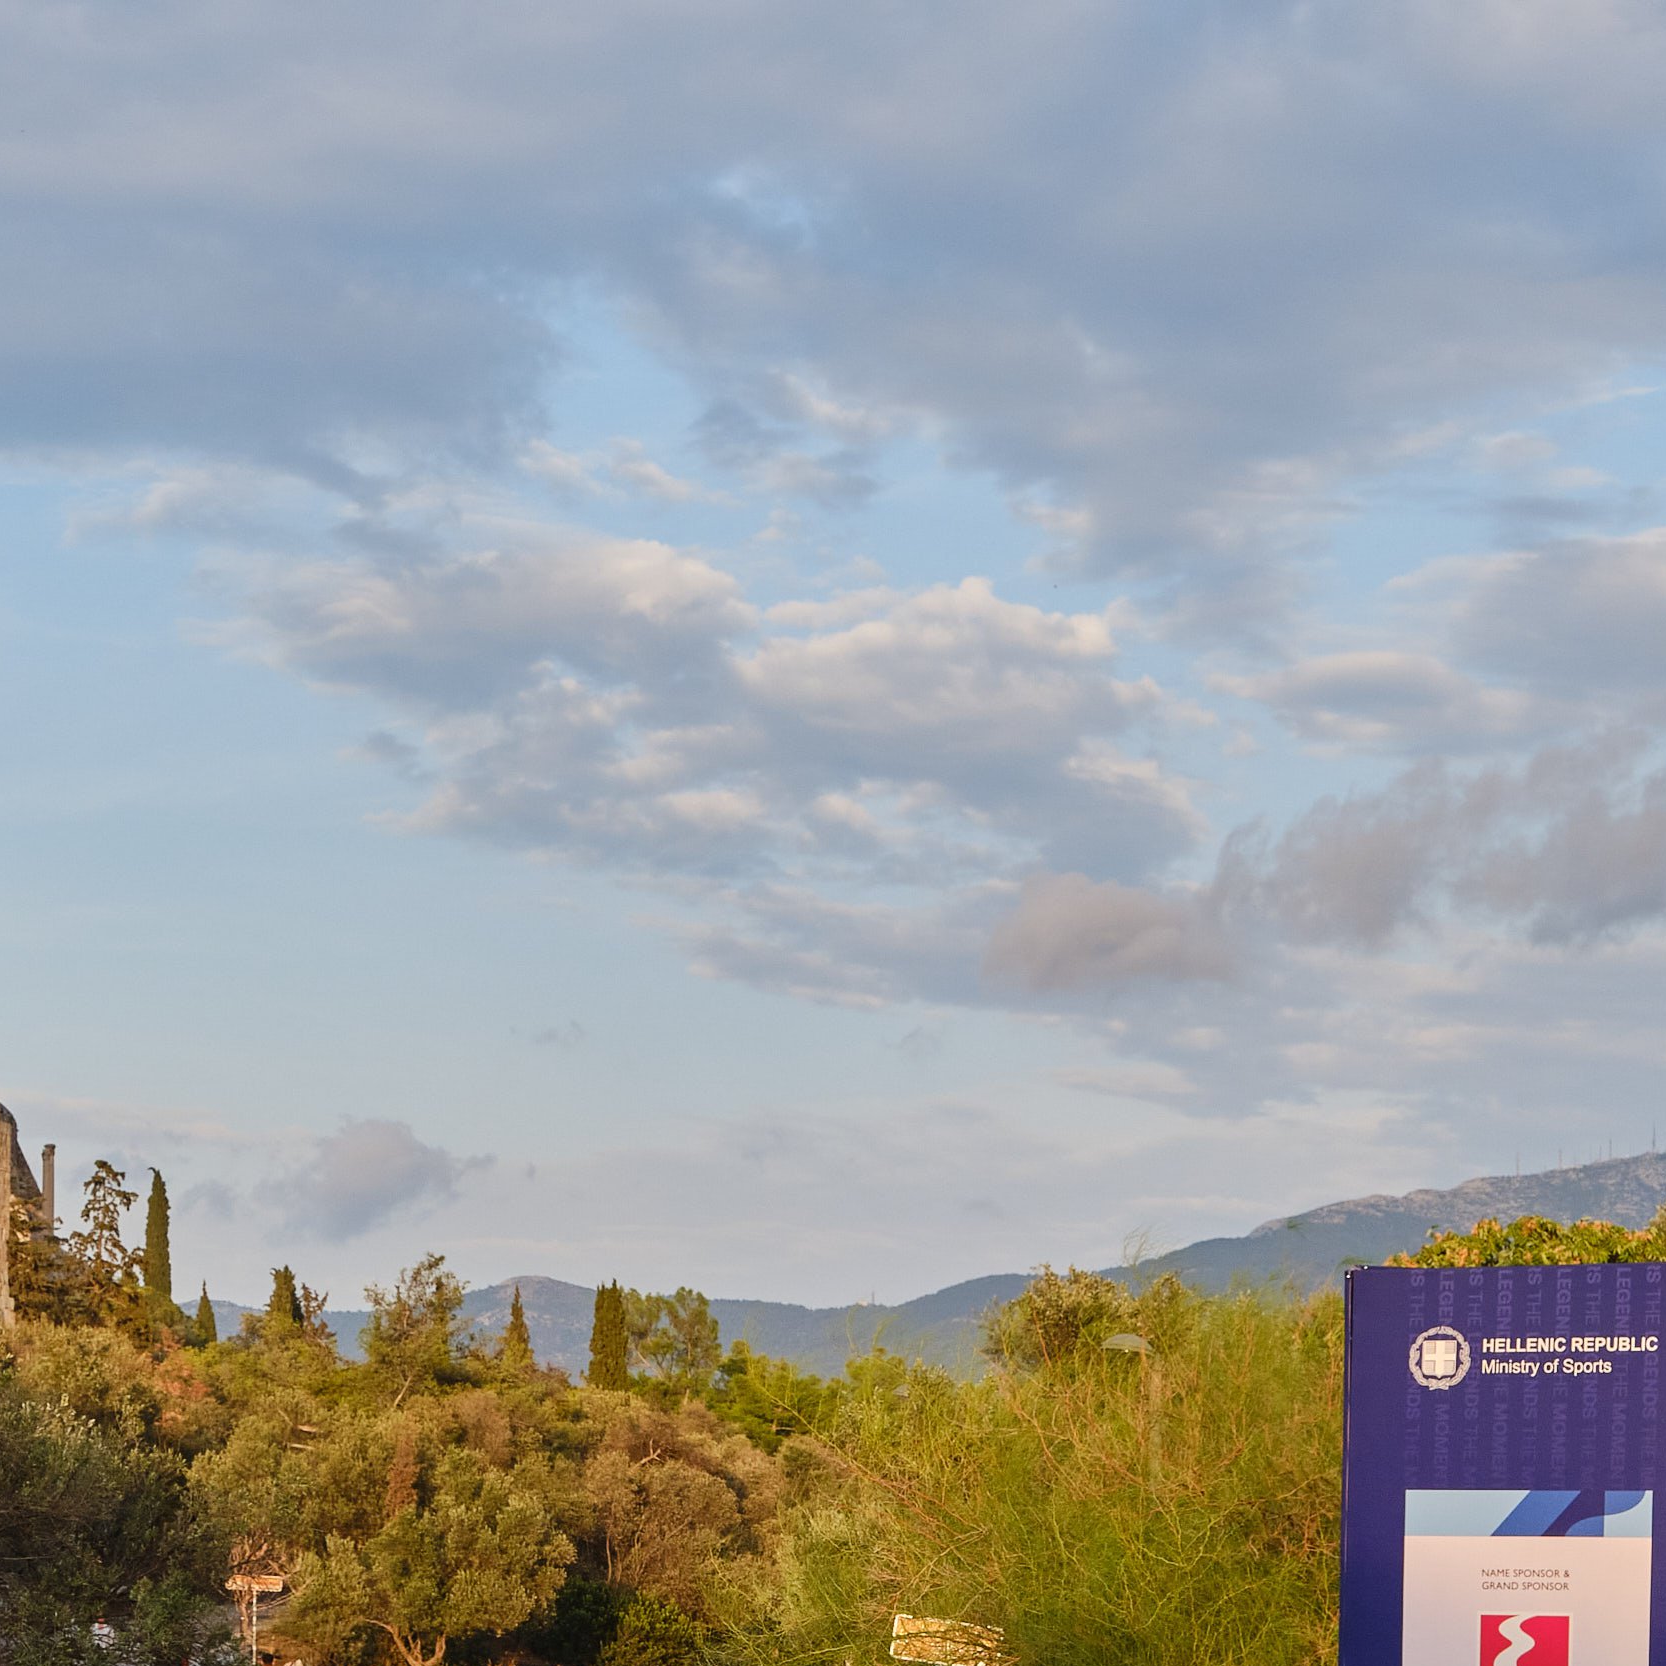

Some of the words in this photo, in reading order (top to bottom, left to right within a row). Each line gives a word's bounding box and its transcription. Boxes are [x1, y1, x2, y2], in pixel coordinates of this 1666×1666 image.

[1482, 1337, 1567, 1353] HELLENIC
[1571, 1336, 1659, 1352] REPUBLIC
[1482, 1359, 1539, 1377] Ministry
[1543, 1359, 1560, 1373] of
[1562, 1359, 1612, 1376] Sports
[1481, 1568, 1510, 1578] NAME
[1513, 1569, 1561, 1579] SPONSOR
[1563, 1570, 1570, 1578] &
[1481, 1581, 1519, 1591] GRAND
[1522, 1582, 1569, 1591] SPONSOR
